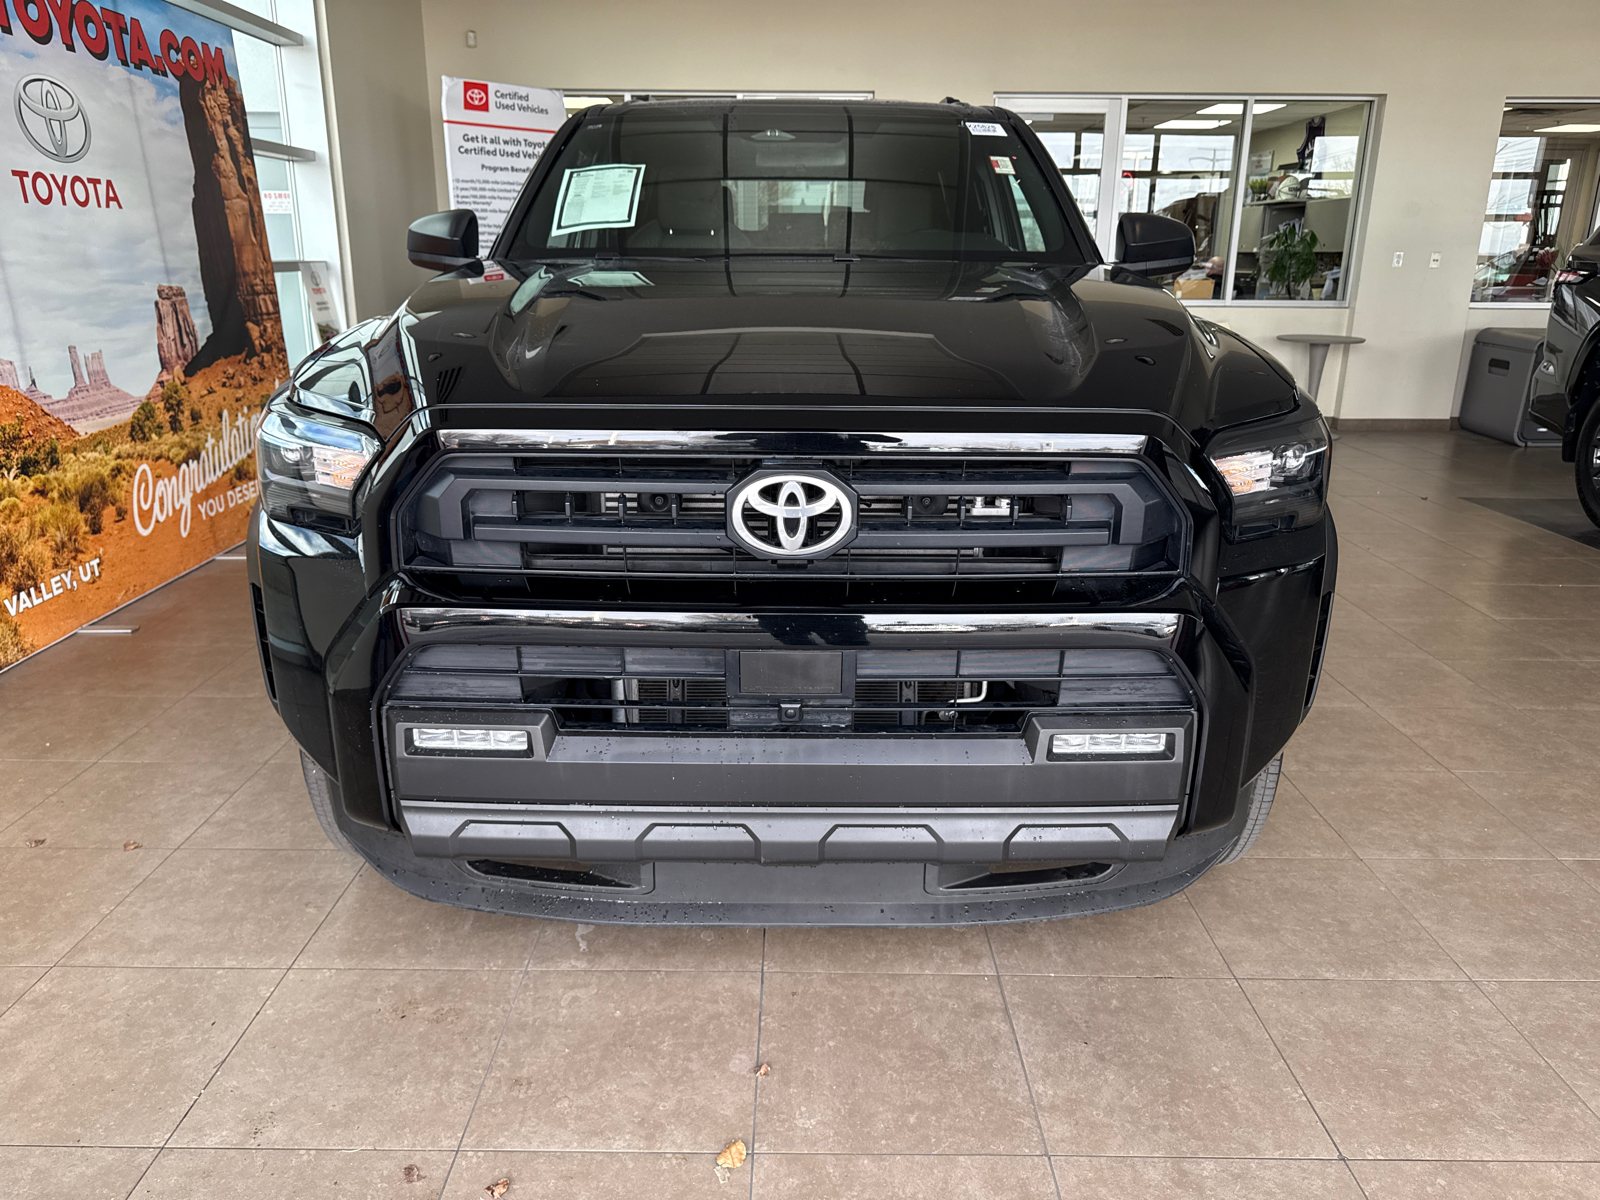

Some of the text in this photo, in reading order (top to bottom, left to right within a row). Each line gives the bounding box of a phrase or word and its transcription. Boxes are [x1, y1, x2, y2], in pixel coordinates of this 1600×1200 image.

[0, 0, 230, 90] OYOTA.COM
[494, 90, 529, 101] Certified
[495, 101, 549, 115] Used Vehicles
[462, 133, 547, 150] Get it all with Toyot
[458, 145, 541, 160] Certified Used Vehi
[481, 164, 510, 173] Program
[11, 169, 123, 209] TOYOTA
[197, 493, 225, 520] YOU
[3, 557, 100, 618] VALLEY, UT
